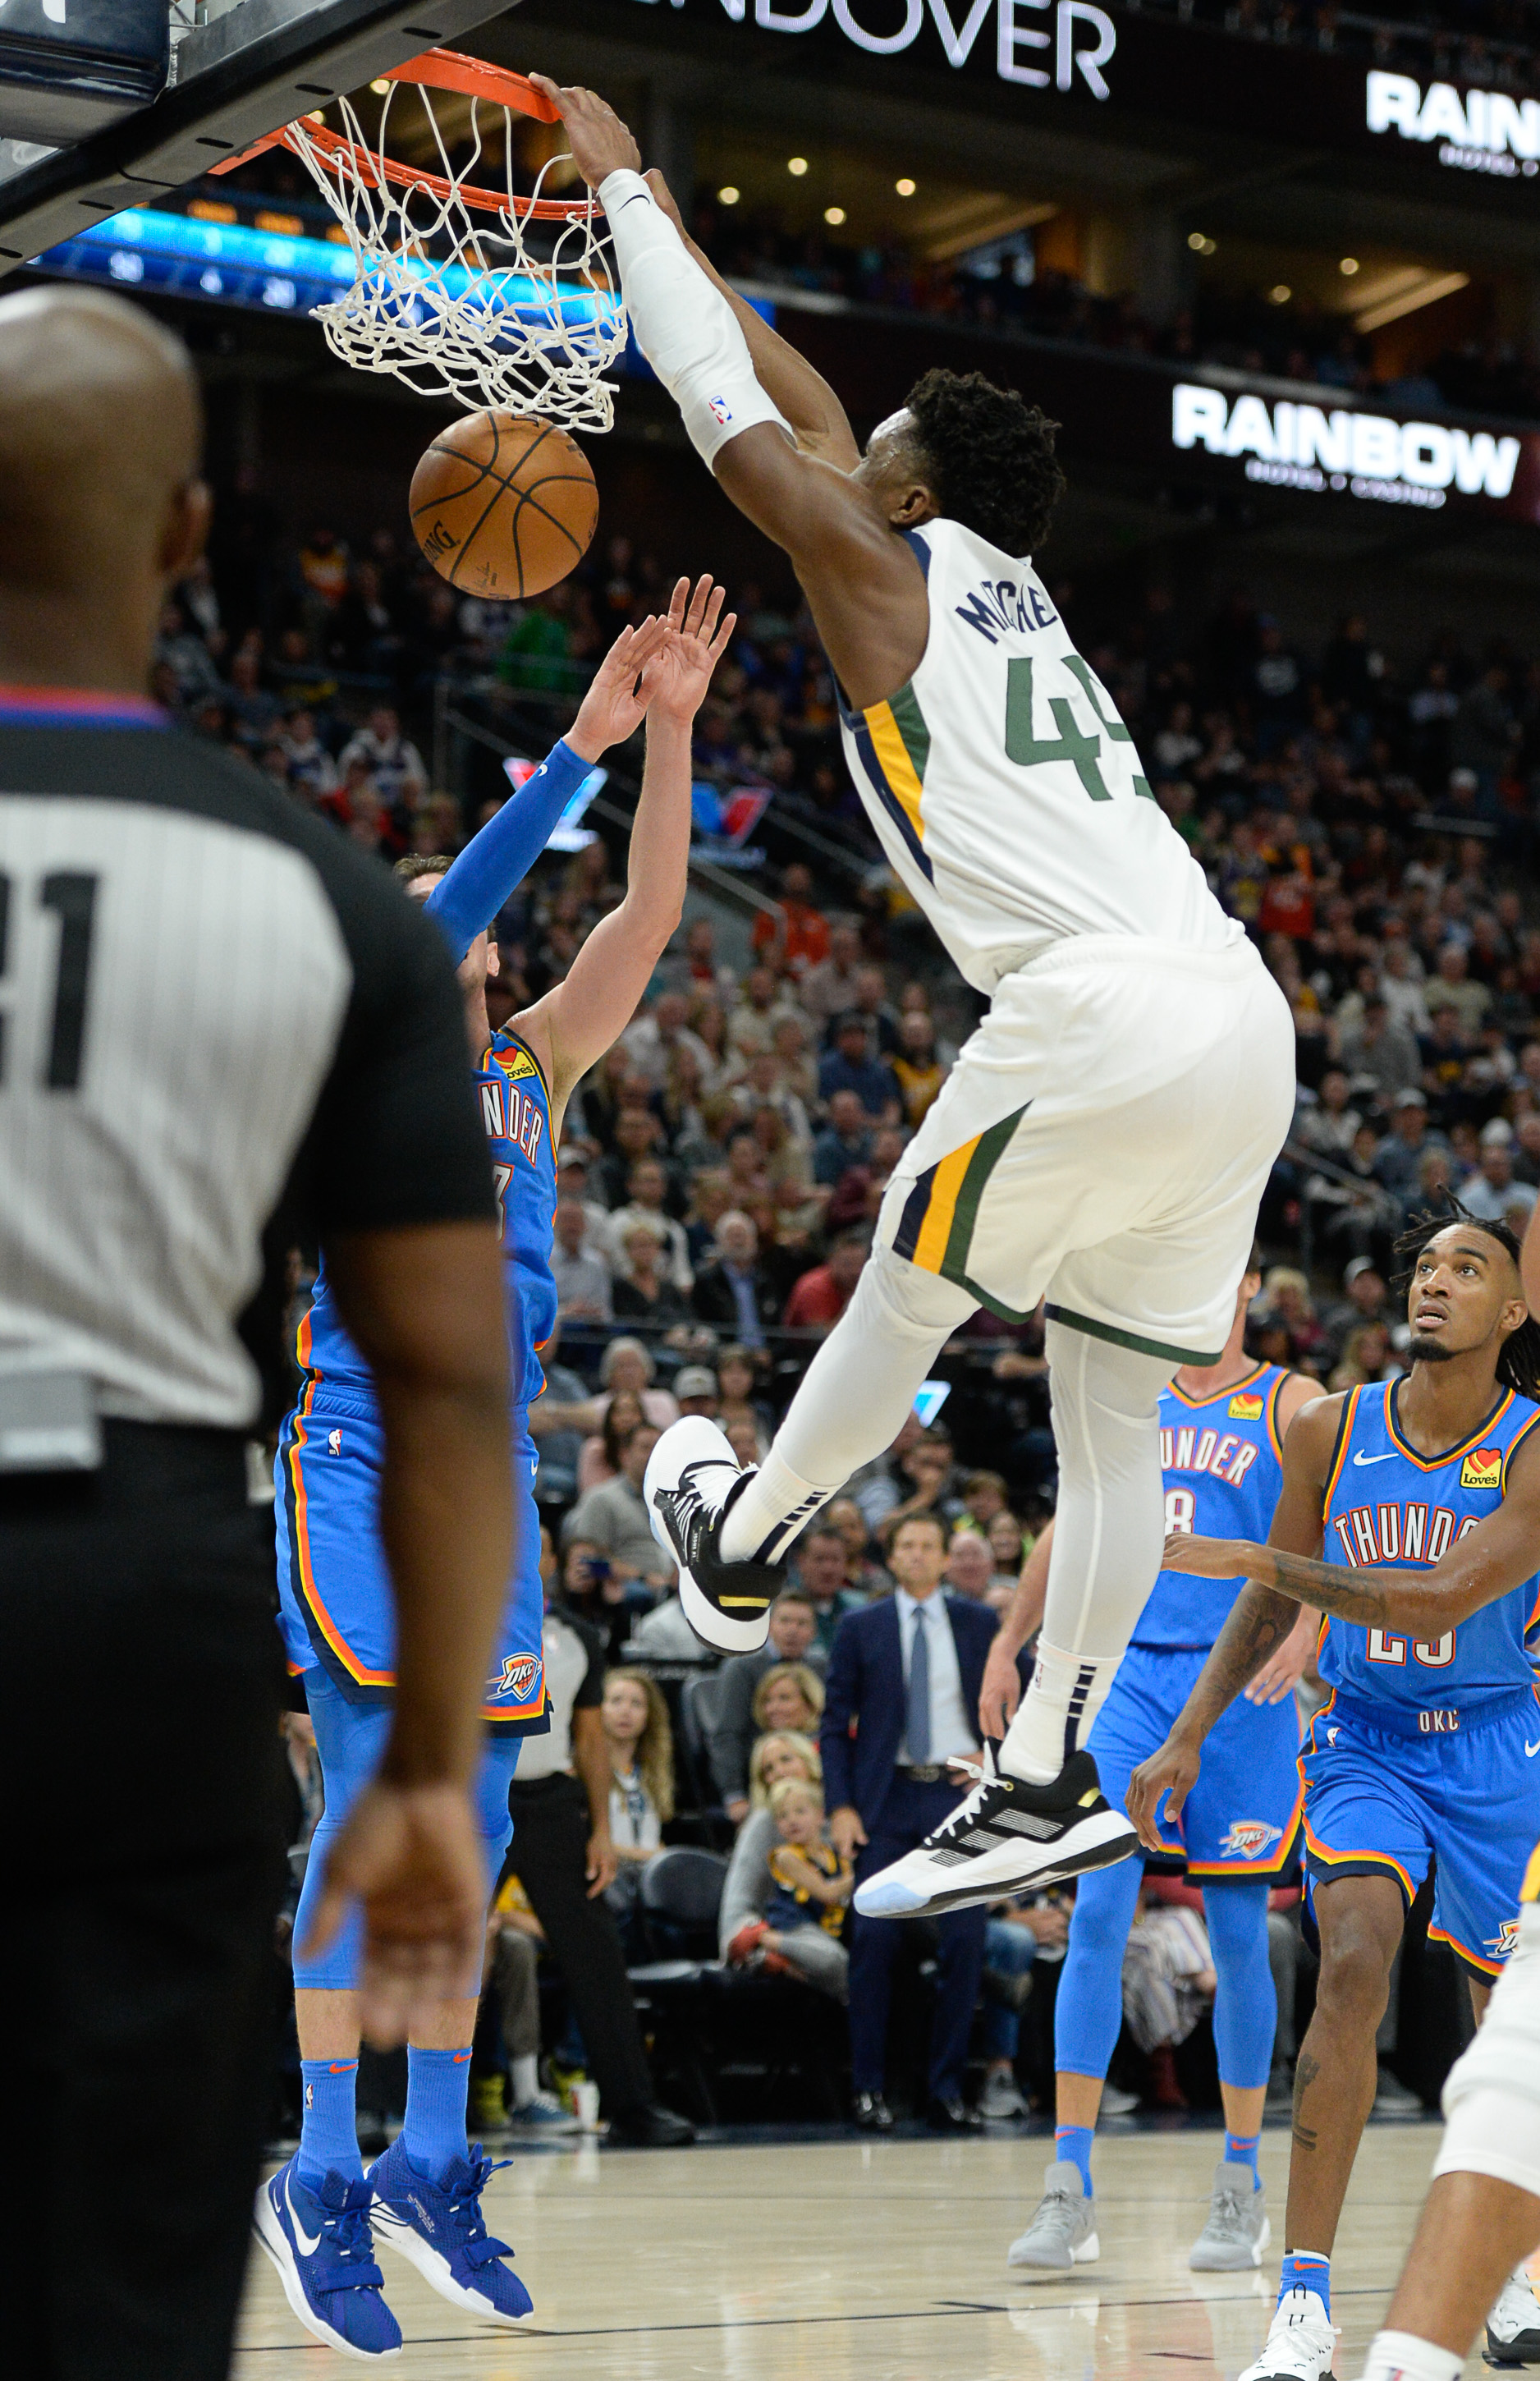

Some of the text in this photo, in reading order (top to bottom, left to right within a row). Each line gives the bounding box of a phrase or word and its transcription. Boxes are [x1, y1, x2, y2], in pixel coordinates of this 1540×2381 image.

[634, 0, 1116, 100] OVER
[1172, 383, 1521, 499] RAINBOW
[0, 871, 99, 1092] 1
[499, 1663, 533, 1691] OKC
[1418, 1708, 1460, 1733] OKC
